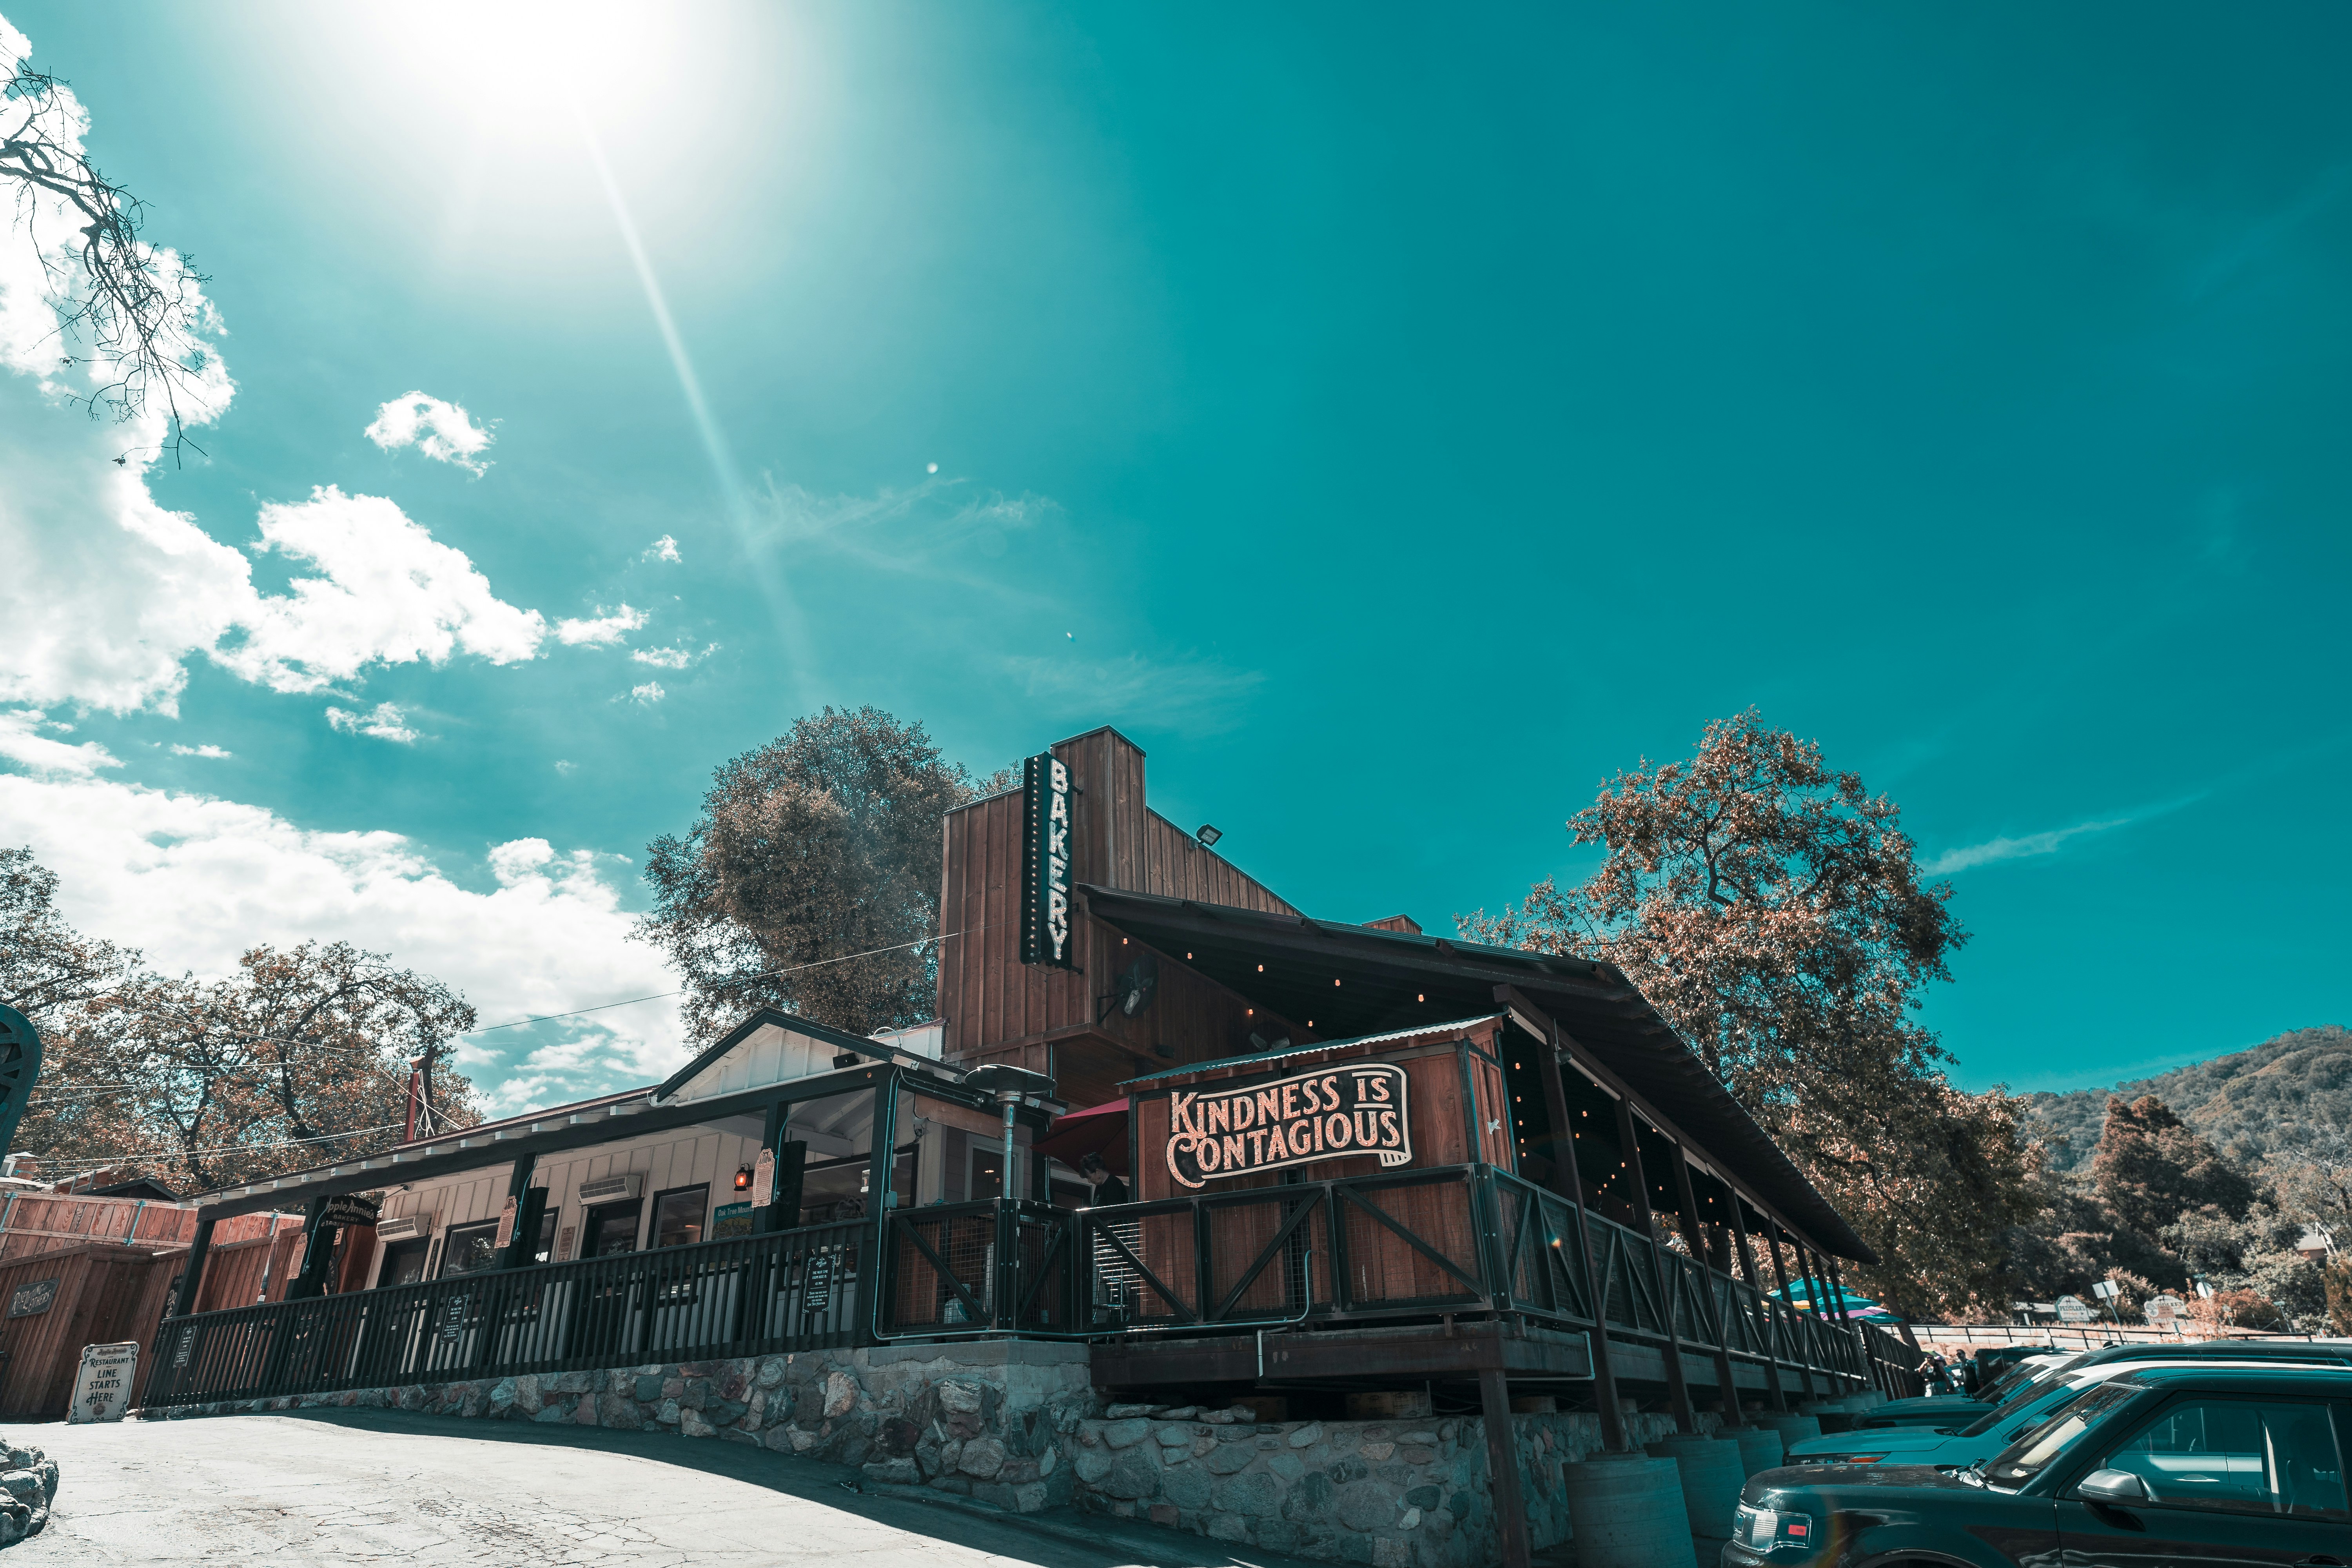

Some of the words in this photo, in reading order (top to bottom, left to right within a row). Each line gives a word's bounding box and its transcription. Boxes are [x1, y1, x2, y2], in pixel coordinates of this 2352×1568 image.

[1048, 759, 1069, 960] BAKERY
[1171, 1076, 1340, 1139] KINDNESS
[1357, 1076, 1390, 1102] IS
[1166, 1111, 1401, 1189] CONTAGIOUS
[345, 1200, 374, 1220] Annie's
[333, 1214, 359, 1222] BAKERY
[89, 1357, 129, 1368] RESTAURANT
[97, 1369, 117, 1378] LINE
[89, 1379, 121, 1390] STARTS
[86, 1392, 114, 1406] HERE
